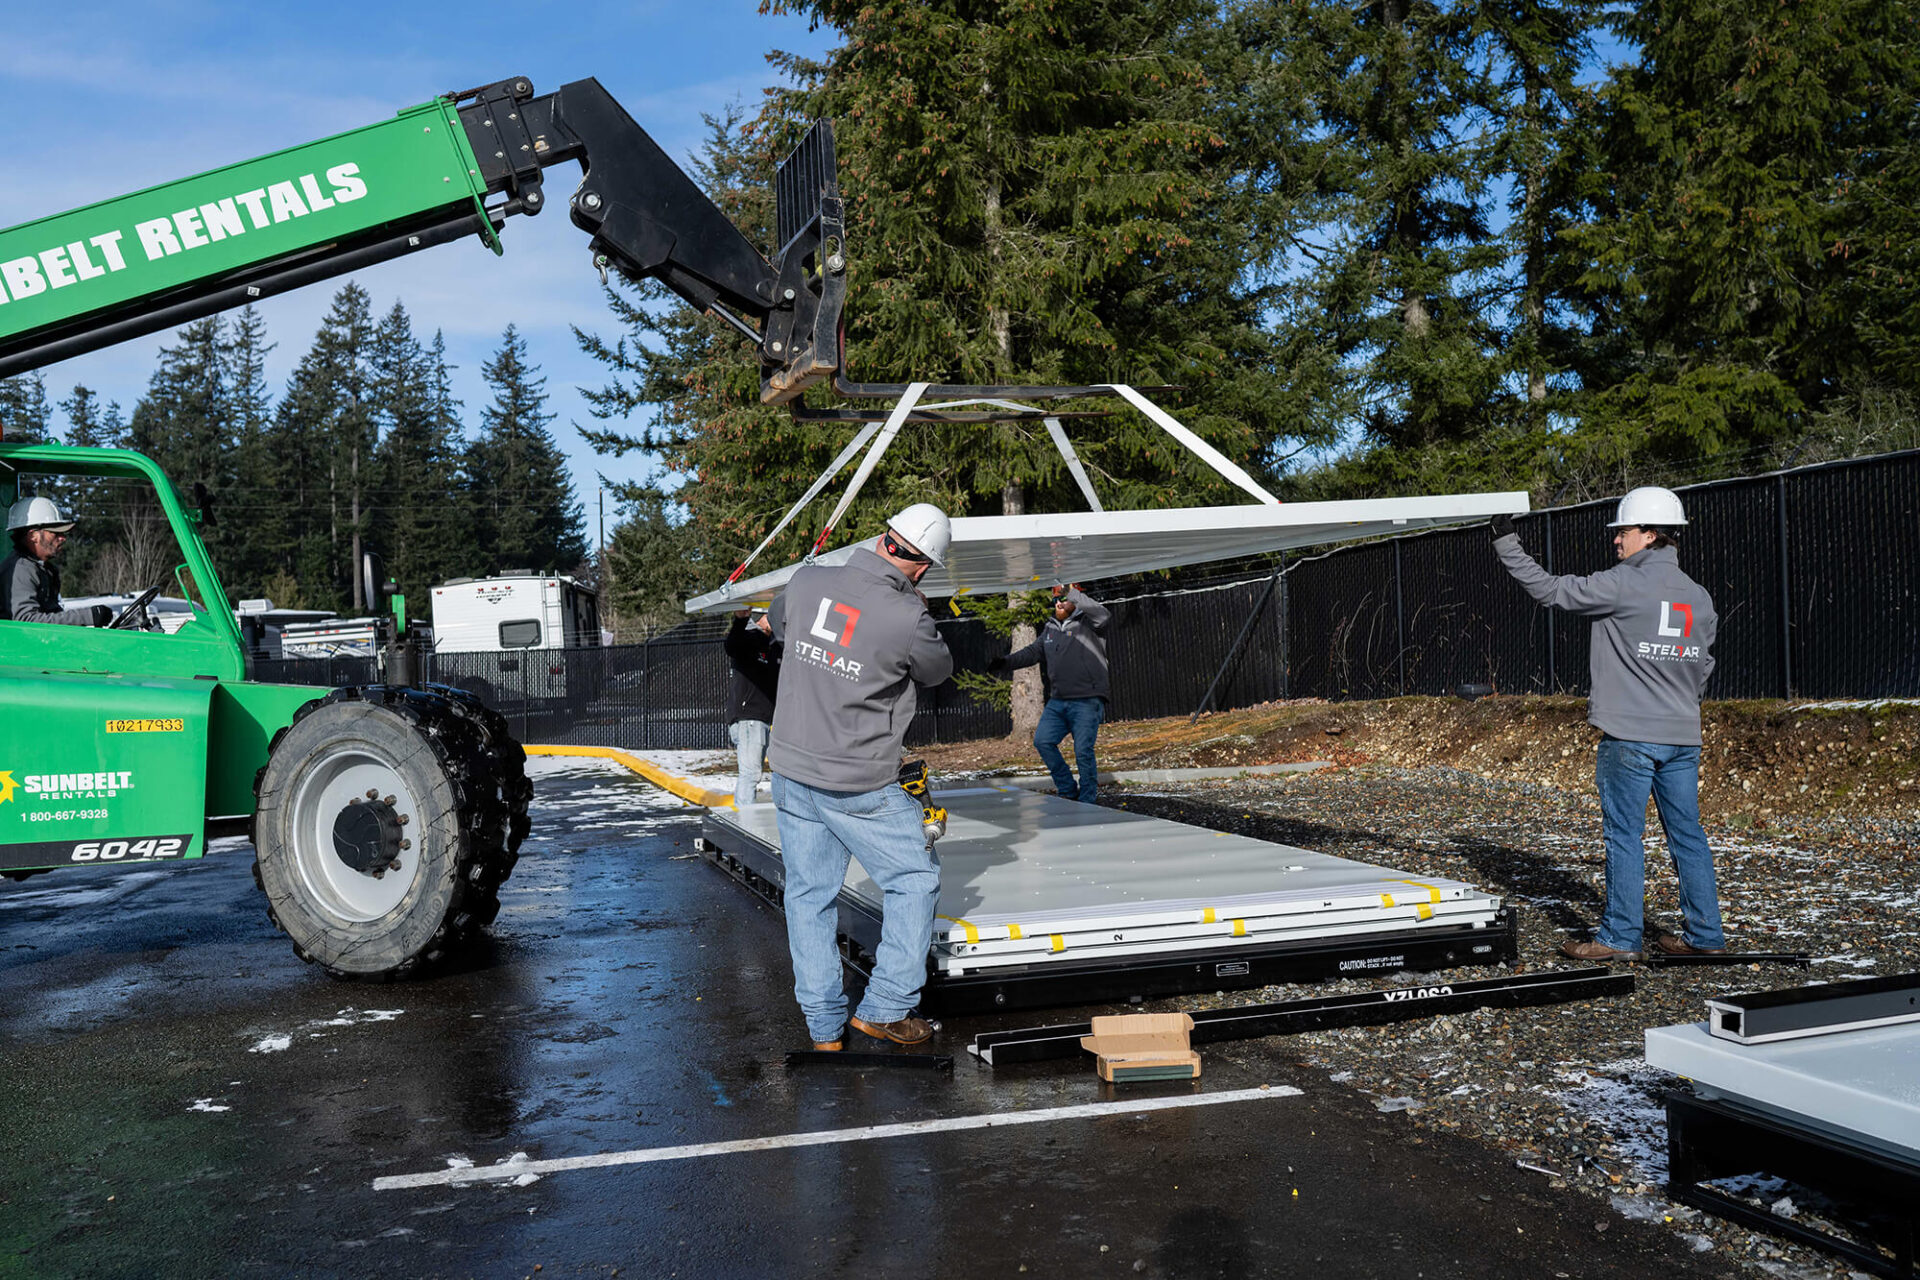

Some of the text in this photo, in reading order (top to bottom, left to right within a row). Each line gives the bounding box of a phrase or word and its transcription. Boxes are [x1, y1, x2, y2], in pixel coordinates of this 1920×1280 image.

[0, 162, 368, 305] BELT RENTALS
[107, 719, 183, 732] 10217933
[24, 771, 132, 793] SUNBELT
[40, 790, 117, 800] RENTALS
[20, 809, 108, 823] 1 800-667-9328
[71, 838, 182, 861] 6042
